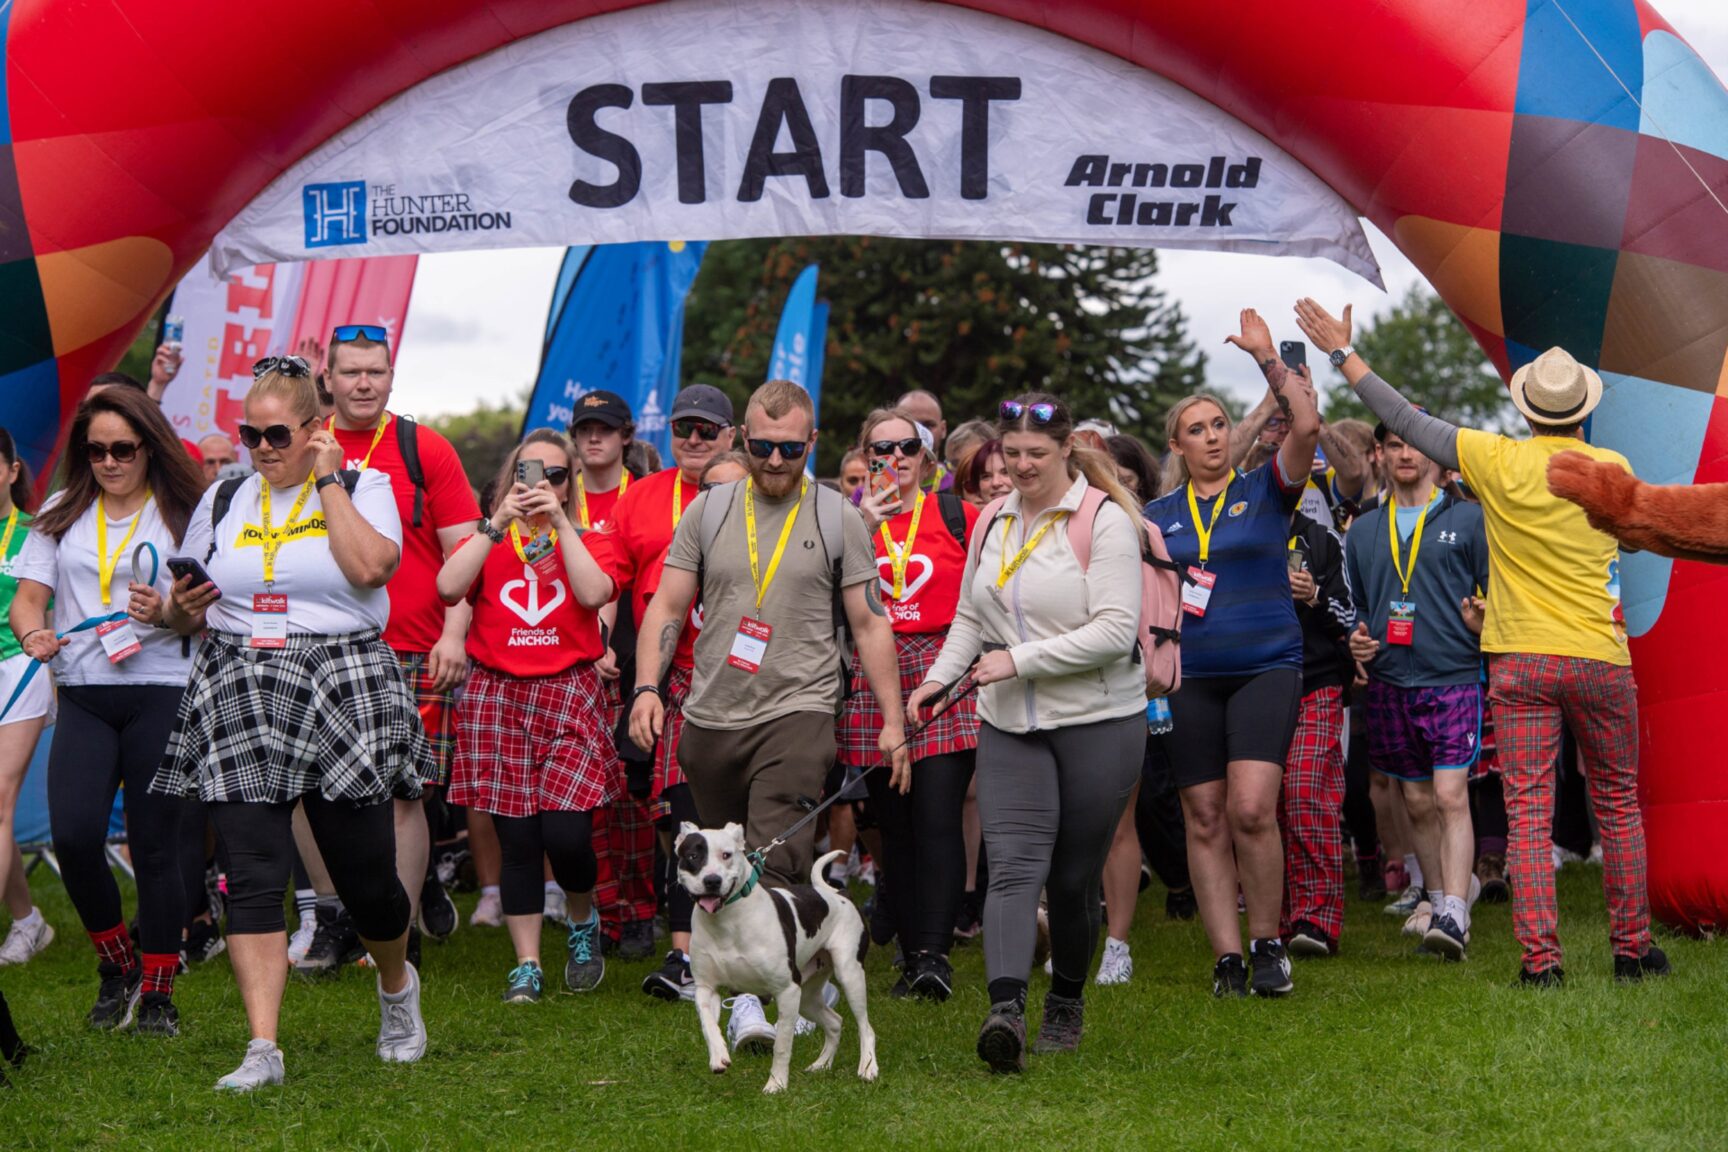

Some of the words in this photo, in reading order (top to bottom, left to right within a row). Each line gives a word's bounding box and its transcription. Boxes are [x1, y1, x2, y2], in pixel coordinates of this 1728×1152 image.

[566, 75, 1022, 208] START
[1064, 155, 1262, 188] Arnold
[372, 184, 395, 196] THE
[371, 193, 472, 217] HUNTER
[1087, 193, 1237, 226] Clark
[372, 212, 512, 236] FOUNDATION
[507, 635, 560, 647] ANCHOR
[511, 627, 545, 636] Friends
[546, 627, 557, 636] of
